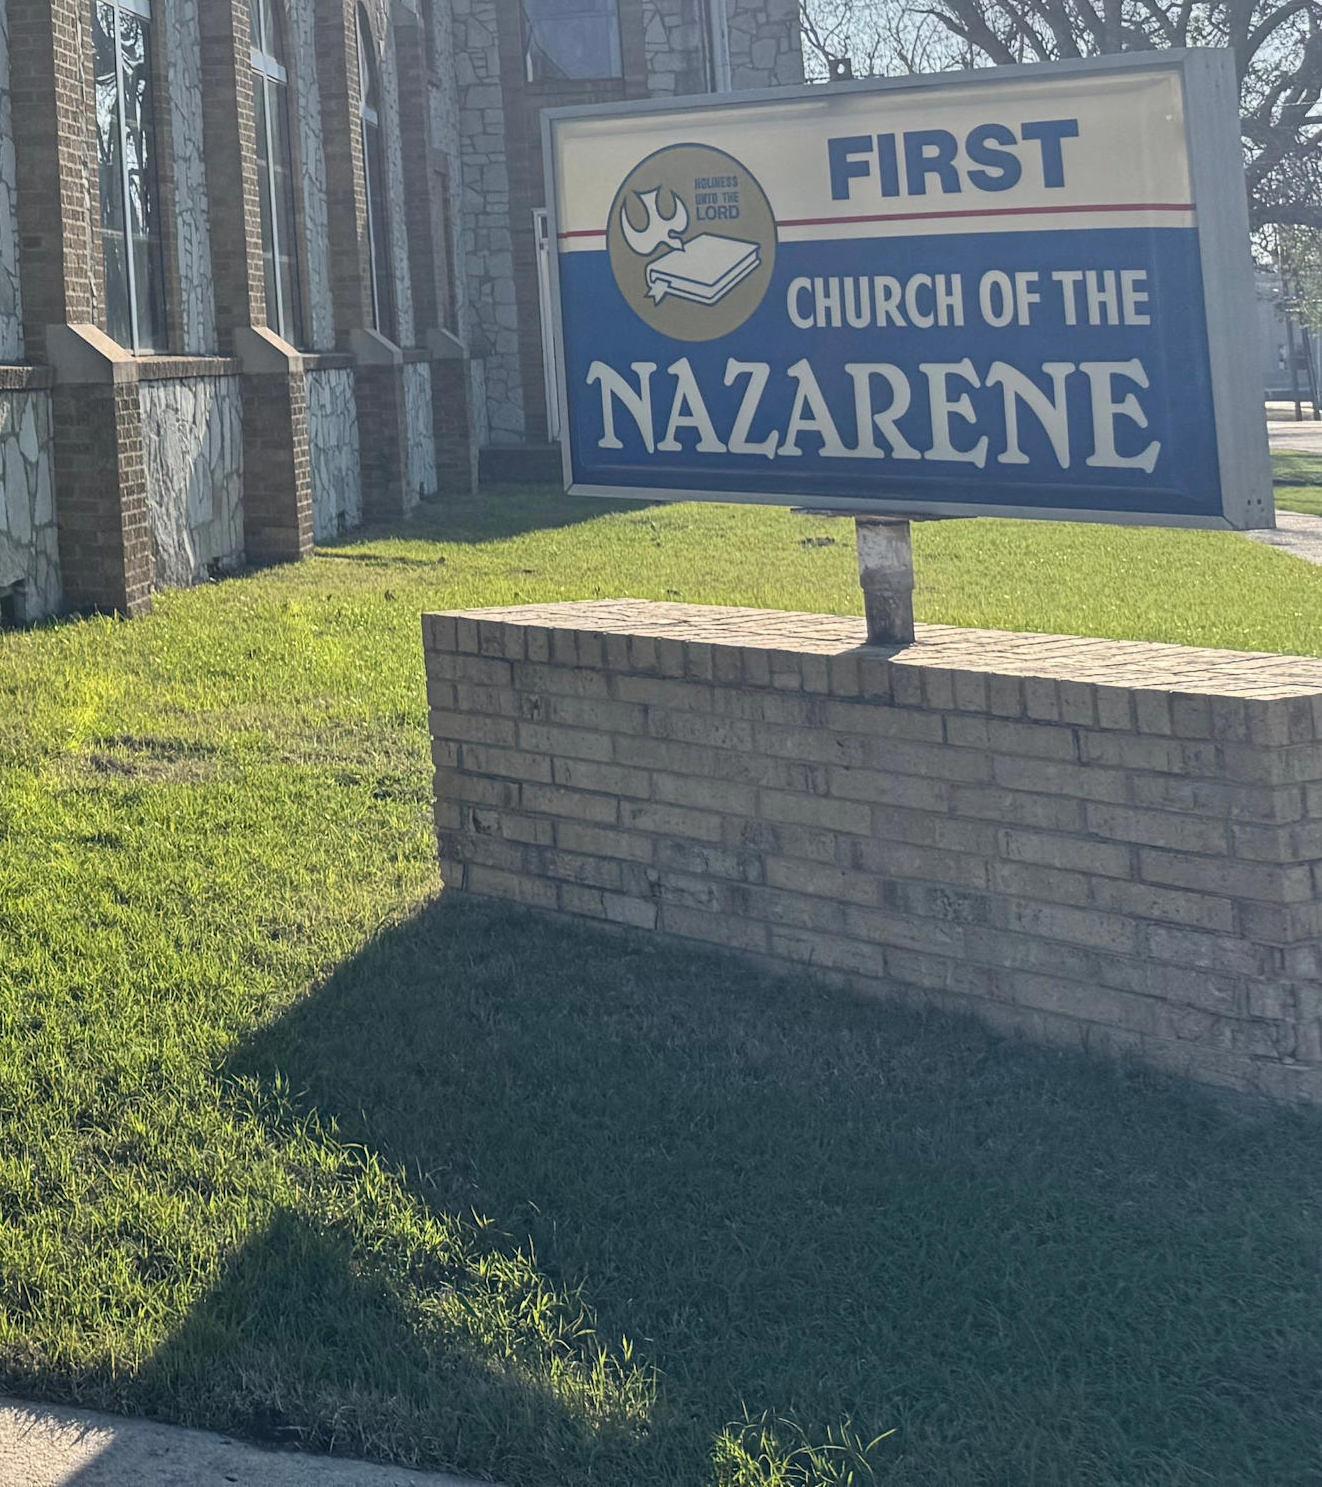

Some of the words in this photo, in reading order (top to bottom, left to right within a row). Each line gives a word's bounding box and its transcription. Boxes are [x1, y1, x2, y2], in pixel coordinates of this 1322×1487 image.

[827, 119, 1079, 201] FIRST
[695, 176, 738, 189] HOLINESS
[695, 193, 718, 205] UNTO
[723, 192, 739, 203] THE
[696, 205, 740, 220] LORD
[786, 271, 965, 329] CHURCH
[979, 270, 1041, 328] OF
[1052, 269, 1151, 326] THE
[586, 356, 1162, 474] NAZARENE
